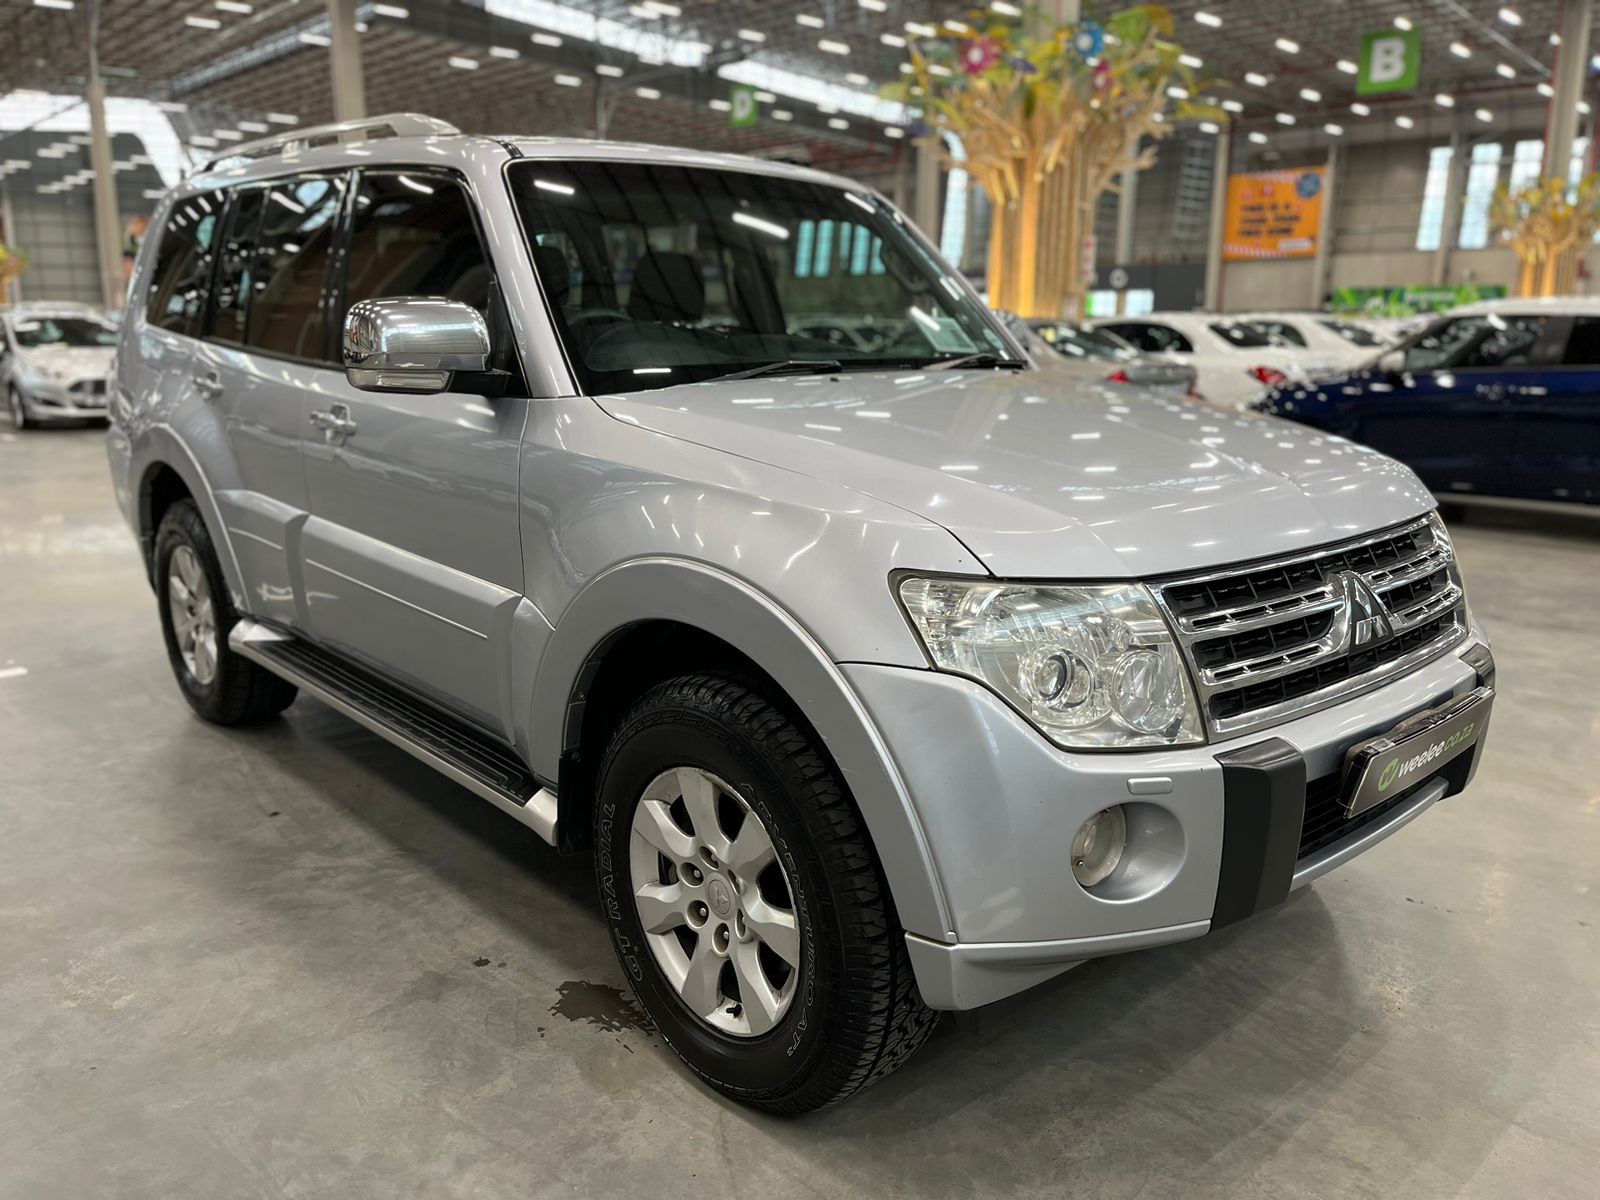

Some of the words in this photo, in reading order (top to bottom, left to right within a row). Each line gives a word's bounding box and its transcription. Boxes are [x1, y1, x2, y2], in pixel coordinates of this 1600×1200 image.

[1369, 37, 1406, 84] B
[600, 802, 622, 921] RADIAL
[614, 926, 643, 982] GT
